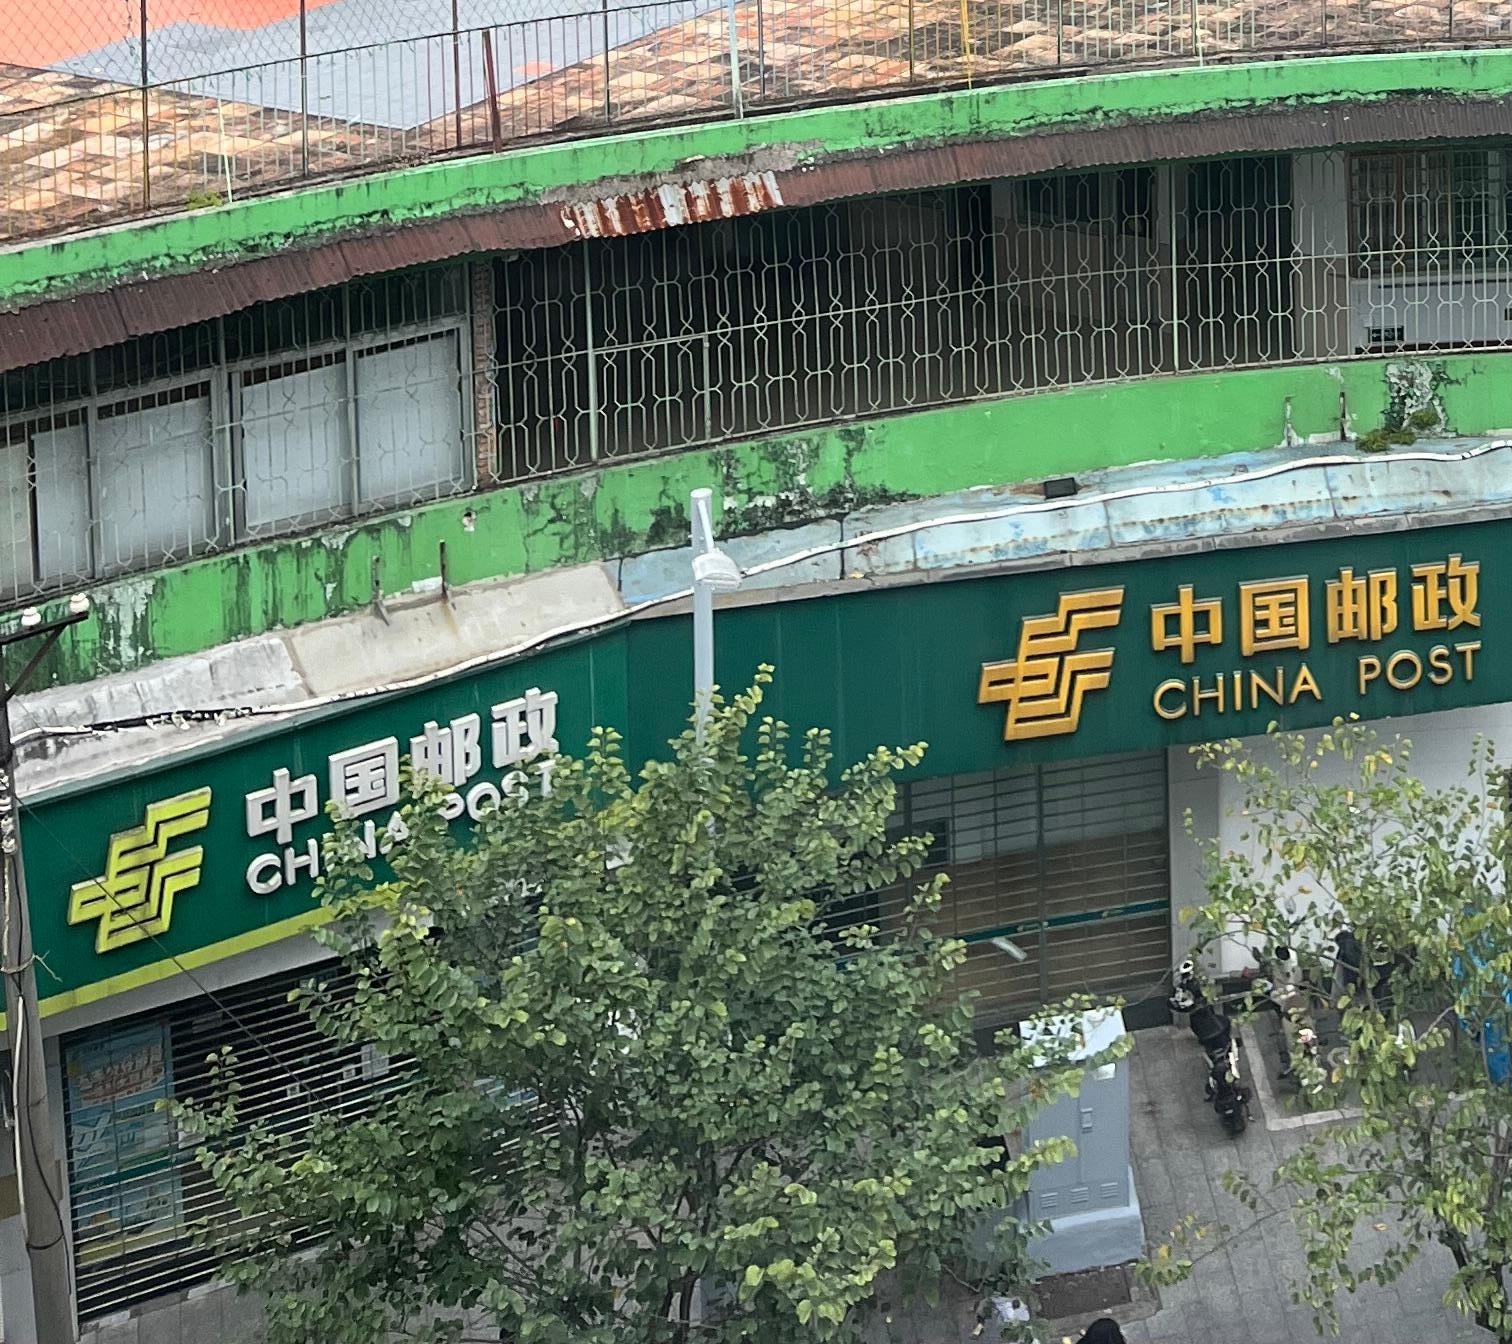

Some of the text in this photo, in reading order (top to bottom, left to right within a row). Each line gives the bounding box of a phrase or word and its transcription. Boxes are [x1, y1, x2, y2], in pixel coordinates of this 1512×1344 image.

[1151, 553, 1480, 663] 中国邮政
[1153, 640, 1481, 720] CHINA POST
[245, 687, 559, 844] 中国邮政
[246, 811, 409, 895] CHNA
